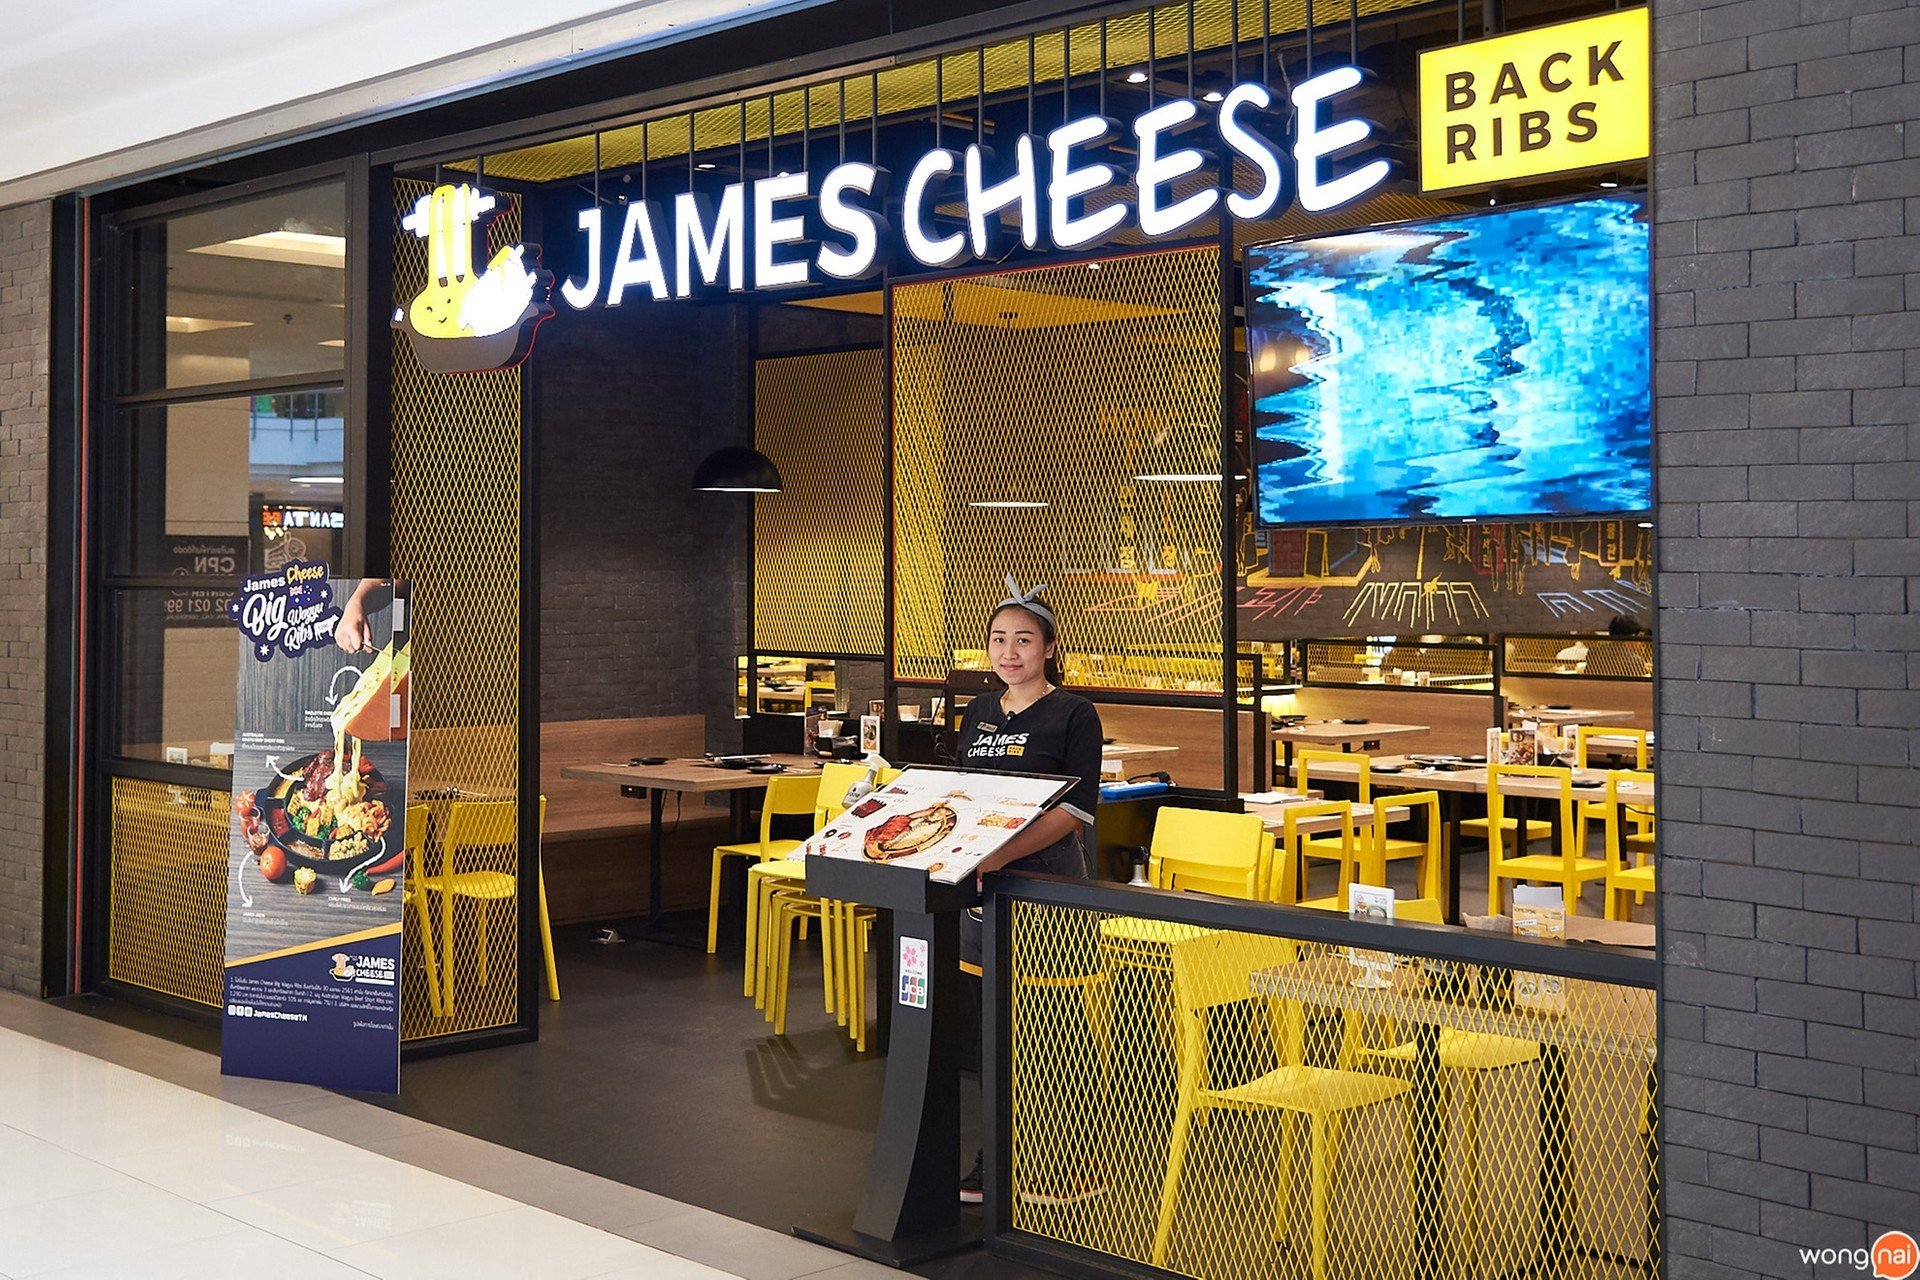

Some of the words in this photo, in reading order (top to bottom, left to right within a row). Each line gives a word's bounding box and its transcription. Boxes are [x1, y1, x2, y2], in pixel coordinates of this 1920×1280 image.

[1445, 40, 1625, 112] BACK
[1446, 102, 1599, 165] RIBS
[560, 163, 881, 311] JAMES
[903, 66, 1392, 267] CHEESE
[243, 576, 286, 593] James
[286, 565, 324, 583] Cheese
[242, 592, 288, 641] Big
[284, 625, 314, 651] Ribs
[967, 745, 1006, 758] CHEESE
[972, 732, 1030, 746] JAMES
[355, 955, 396, 971] JAMES
[356, 969, 384, 979] CHEESE
